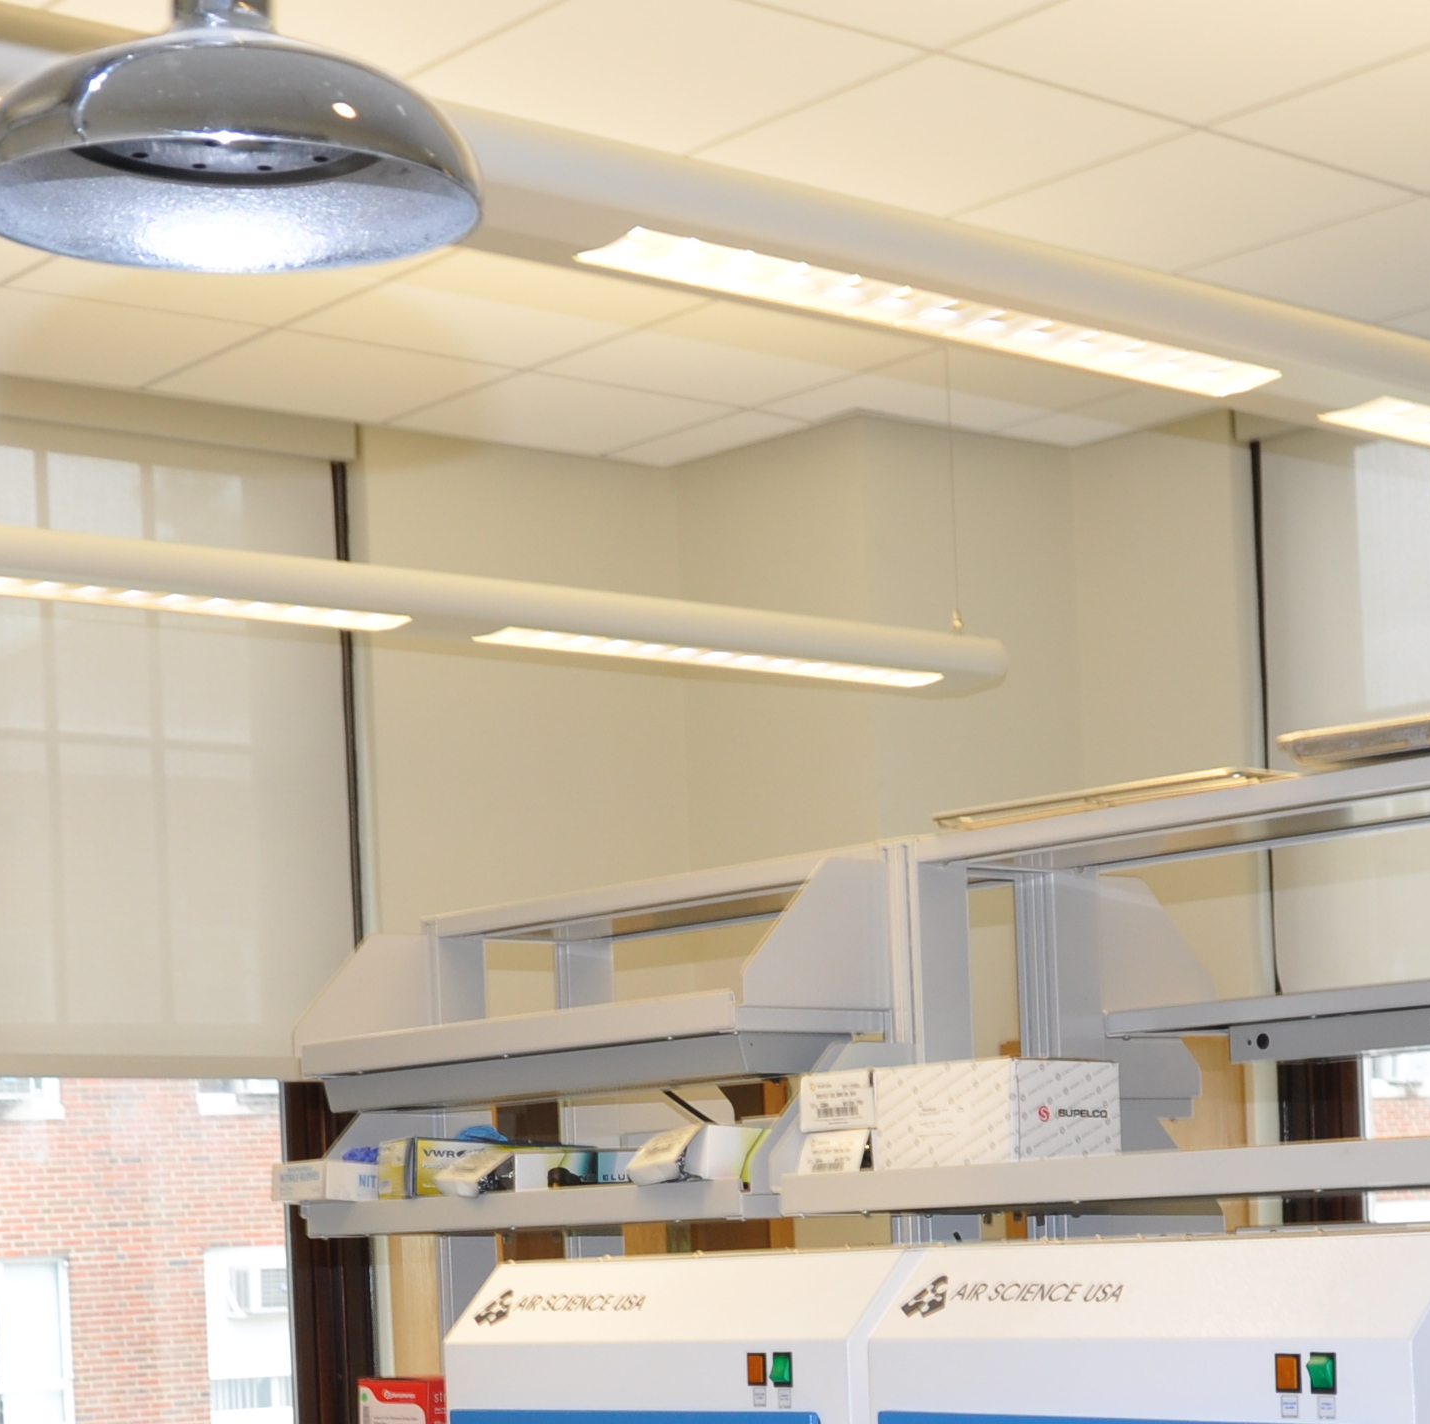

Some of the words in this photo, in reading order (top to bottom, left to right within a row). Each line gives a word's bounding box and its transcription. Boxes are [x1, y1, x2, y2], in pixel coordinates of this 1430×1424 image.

[1058, 1108, 1108, 1118] SUPELCO
[423, 1148, 457, 1159] VWR
[951, 1282, 988, 1302] AIR
[988, 1282, 1082, 1302] SCIENCE
[1083, 1283, 1124, 1303] USA
[516, 1294, 543, 1312] AIR
[542, 1294, 615, 1312] SCIENCE
[613, 1294, 646, 1312] USA
